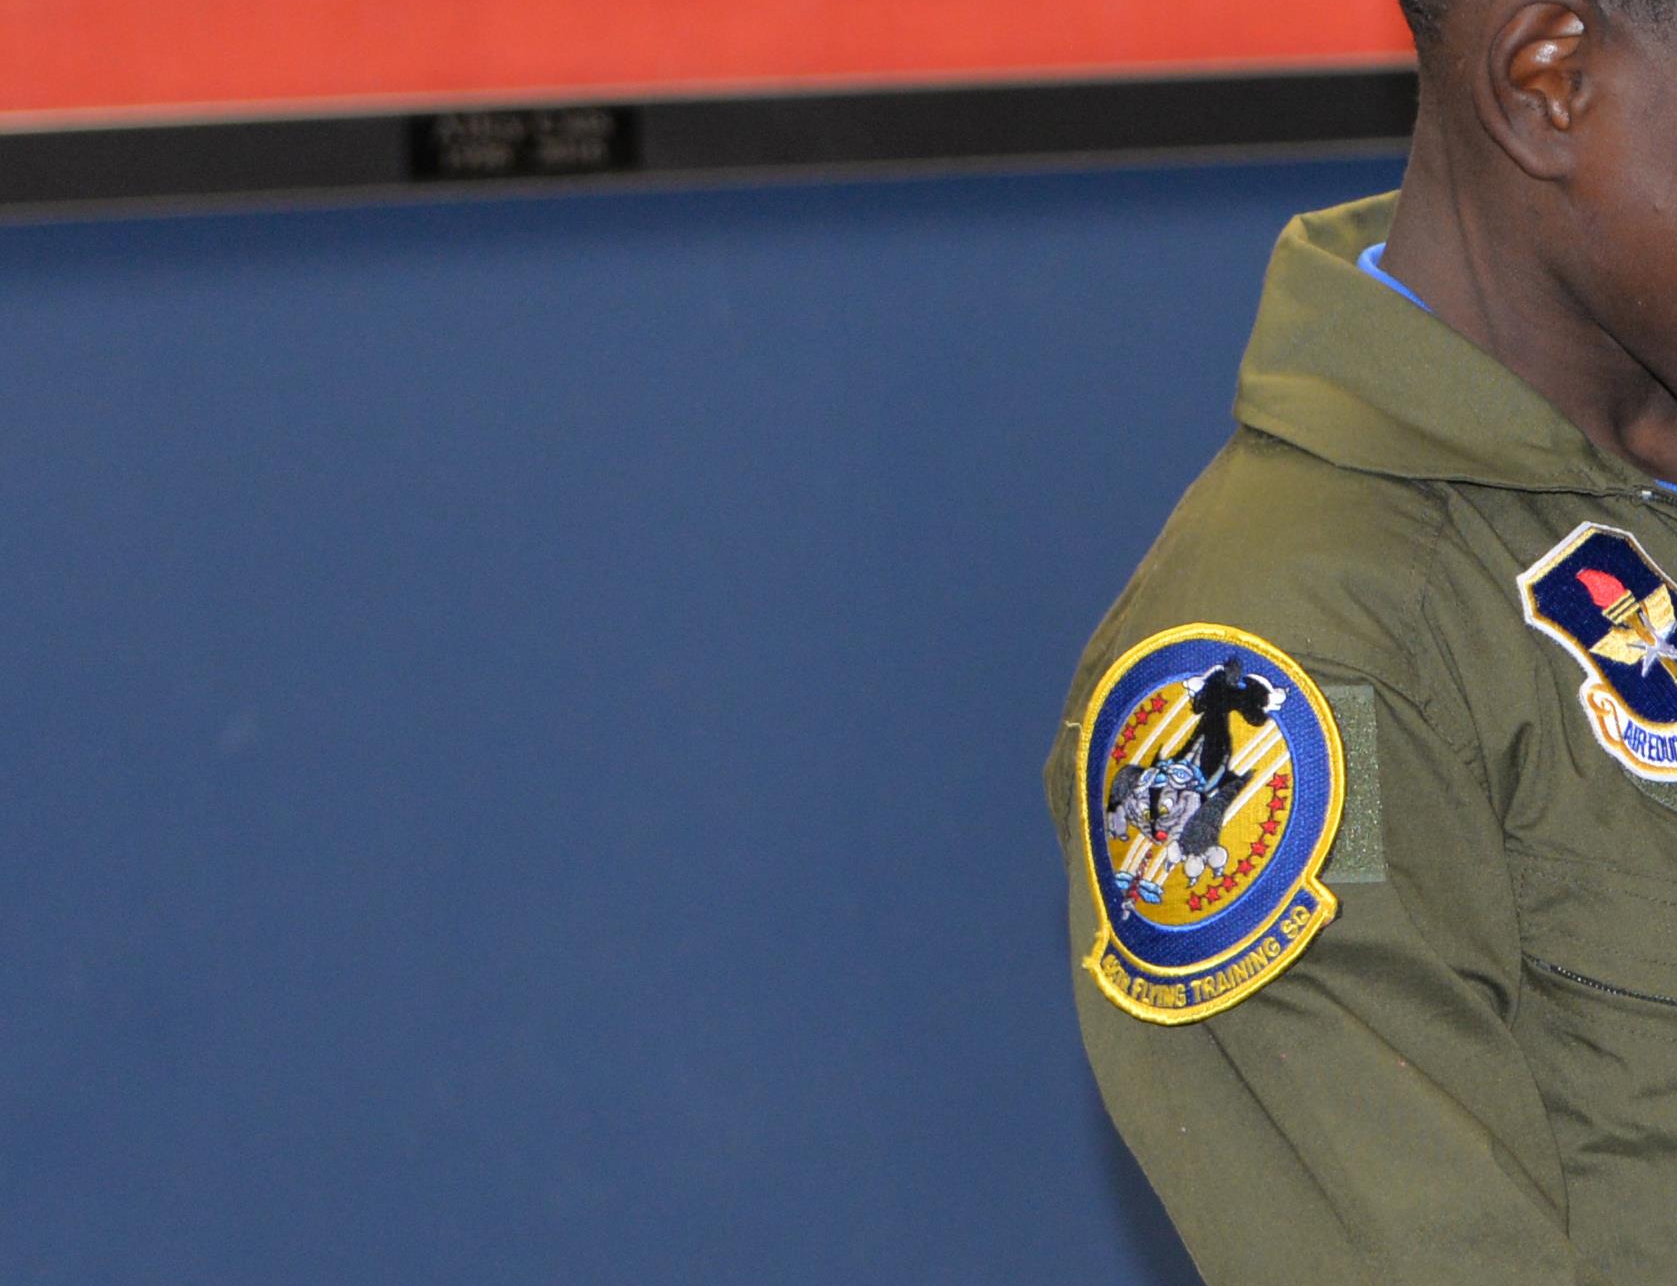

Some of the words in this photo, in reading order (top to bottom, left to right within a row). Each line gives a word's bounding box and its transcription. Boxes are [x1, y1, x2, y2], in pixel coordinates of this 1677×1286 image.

[1623, 719, 1647, 758] AIR
[1130, 977, 1188, 1008] FLYING
[1190, 936, 1281, 1004] TRAINING
[1280, 905, 1312, 939] SQ
